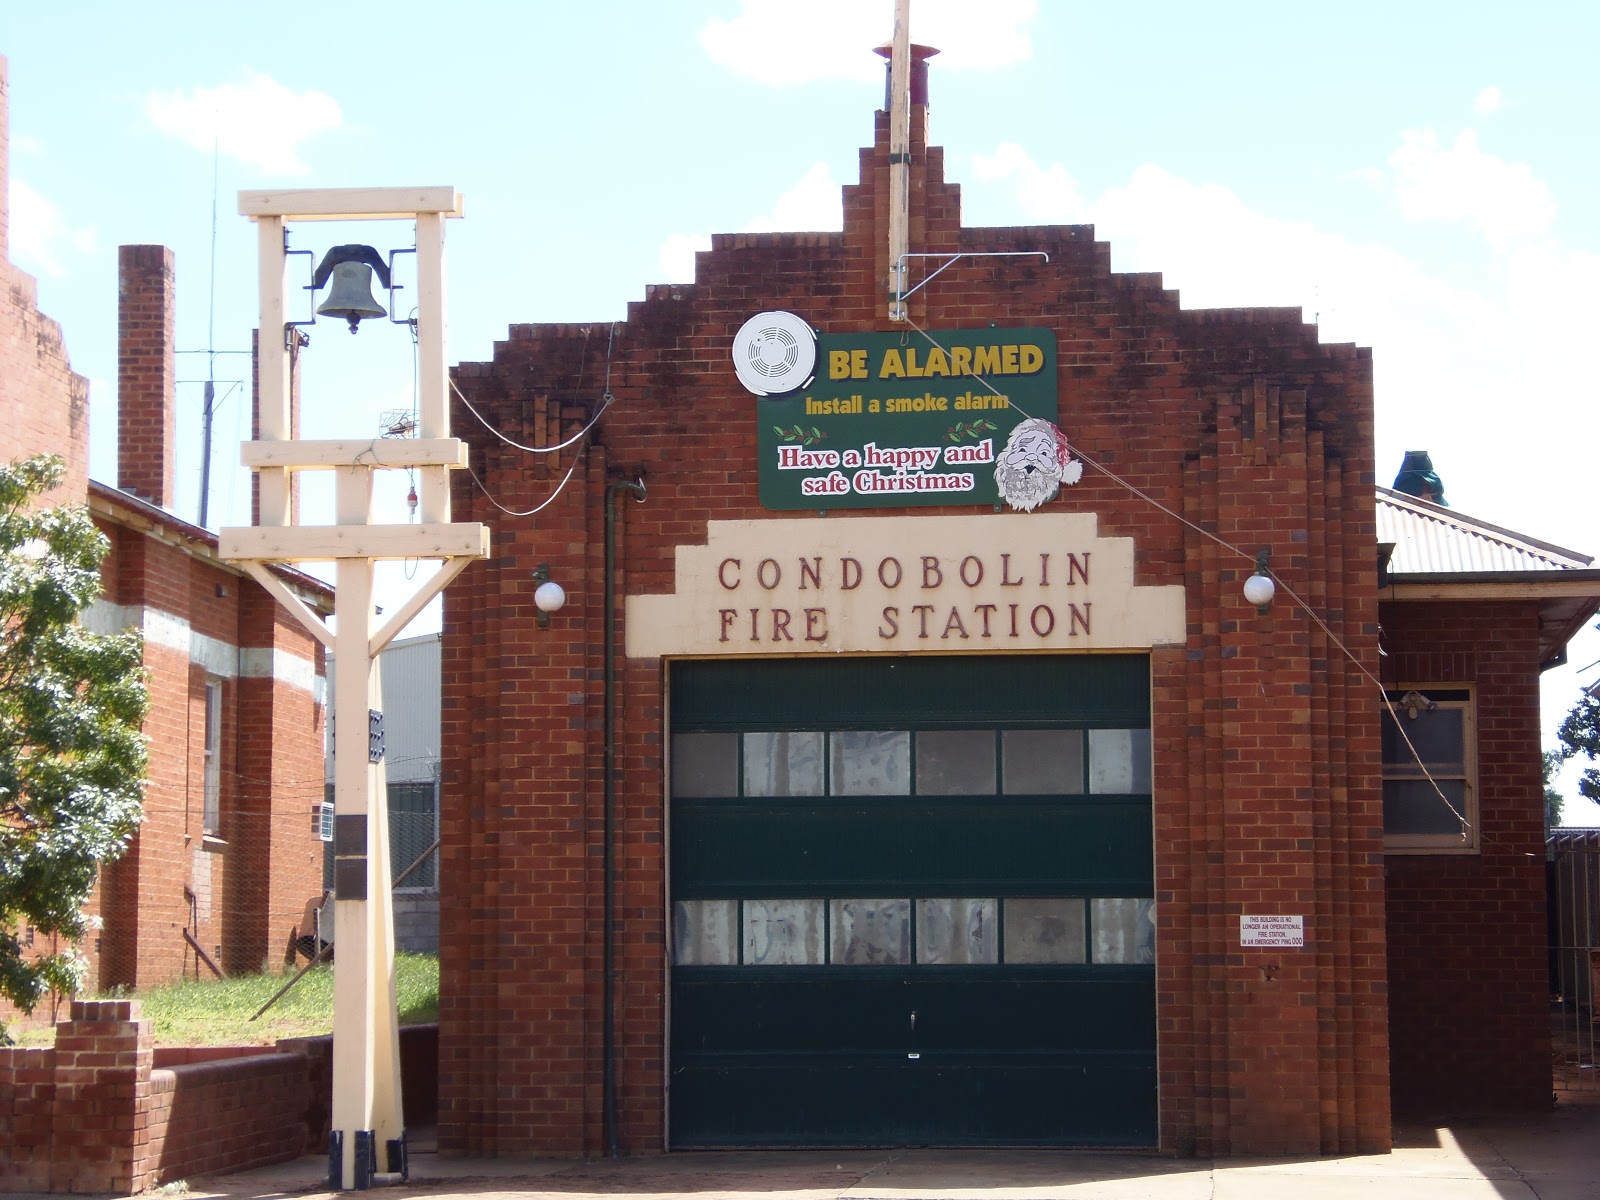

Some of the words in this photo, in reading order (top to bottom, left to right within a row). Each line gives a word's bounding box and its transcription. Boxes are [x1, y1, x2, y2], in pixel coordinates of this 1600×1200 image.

[829, 349, 870, 380] BE
[879, 344, 1045, 379] ALARMED
[805, 396, 862, 415] Install
[868, 401, 880, 414] a
[886, 397, 948, 412] smoke
[954, 393, 1009, 410] alarm
[779, 447, 839, 469] Have
[844, 452, 861, 467] a
[864, 442, 939, 471] happy
[945, 439, 993, 465] and
[802, 472, 850, 495] safe
[853, 471, 974, 493] Christmas
[718, 552, 1092, 591] CONDOBOLIN
[718, 608, 828, 642] FIRE
[878, 603, 1093, 640] STATION
